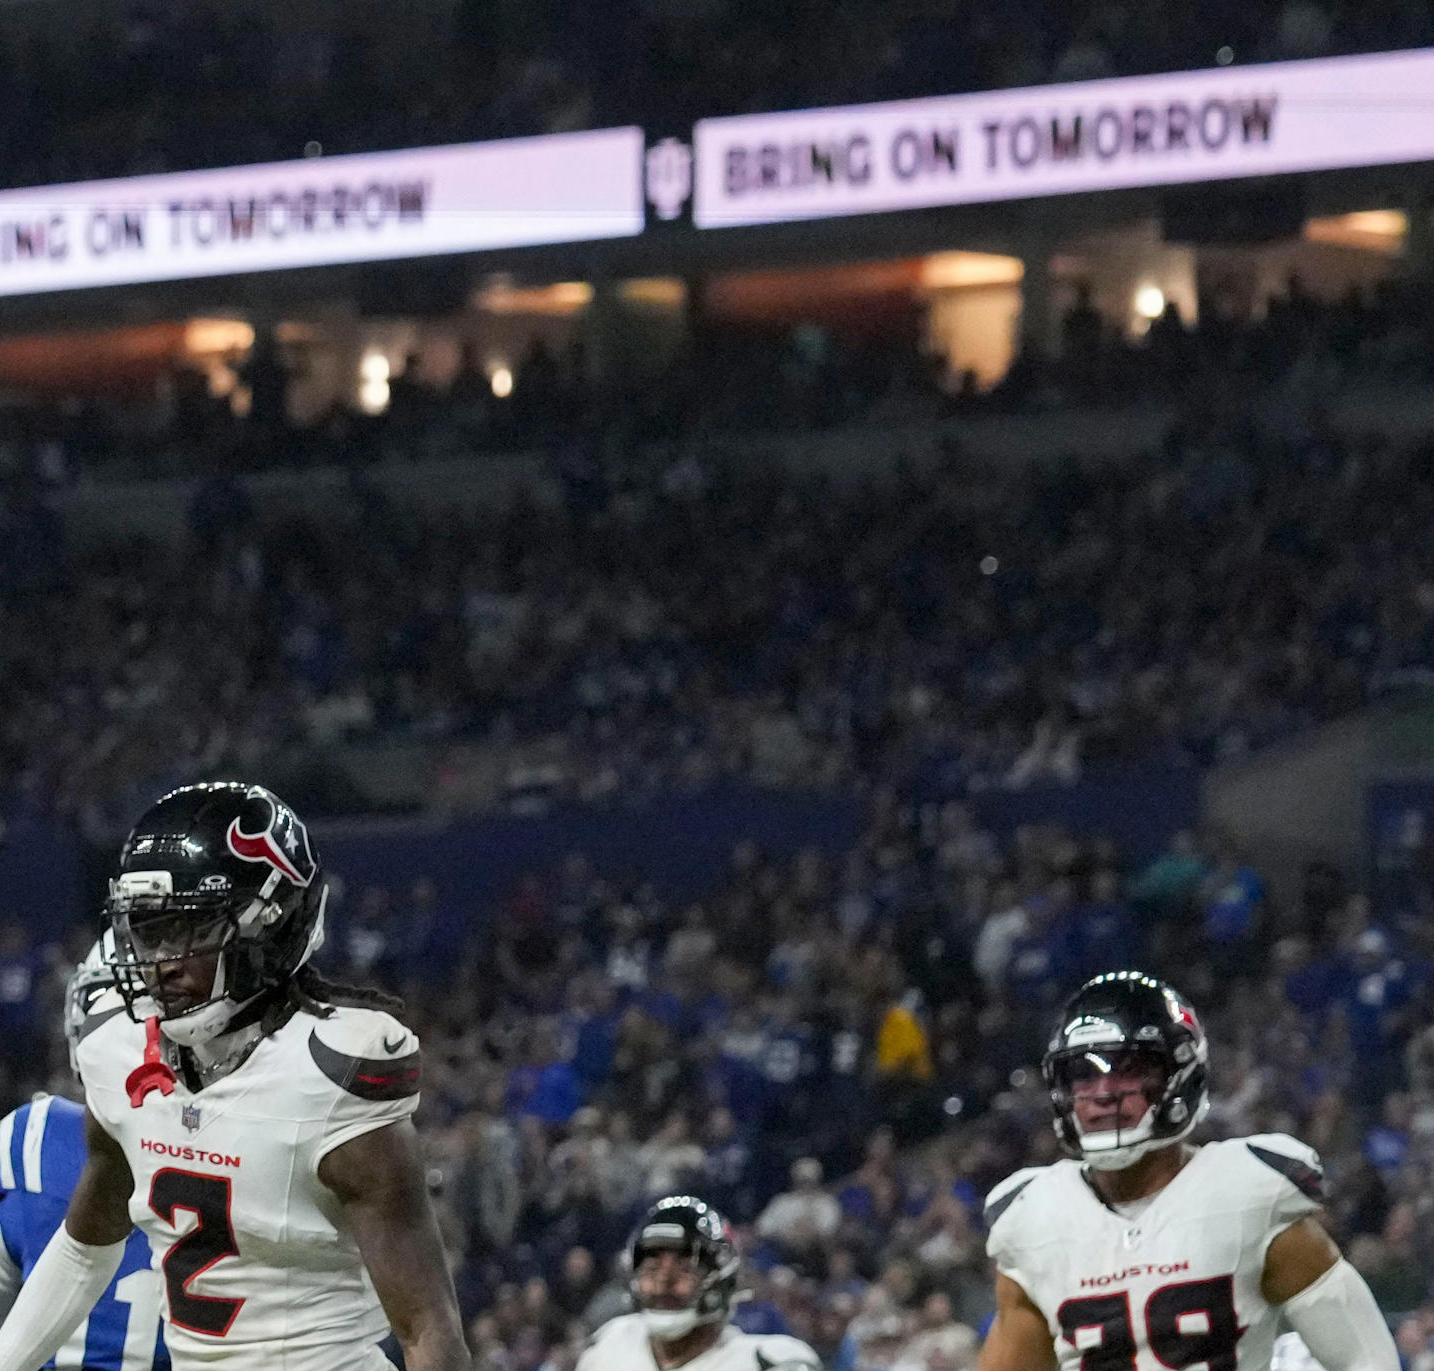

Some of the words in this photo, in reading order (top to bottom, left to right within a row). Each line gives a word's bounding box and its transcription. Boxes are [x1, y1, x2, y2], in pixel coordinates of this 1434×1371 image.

[724, 136, 873, 196] BRING
[890, 129, 960, 180] ON
[980, 90, 1279, 168] TOMORROW
[85, 209, 145, 256] ON
[165, 180, 429, 246] TOMORROW
[140, 1138, 241, 1168] HOUSTON
[148, 1166, 246, 1338] 2
[1079, 1260, 1190, 1288] HOUSTON
